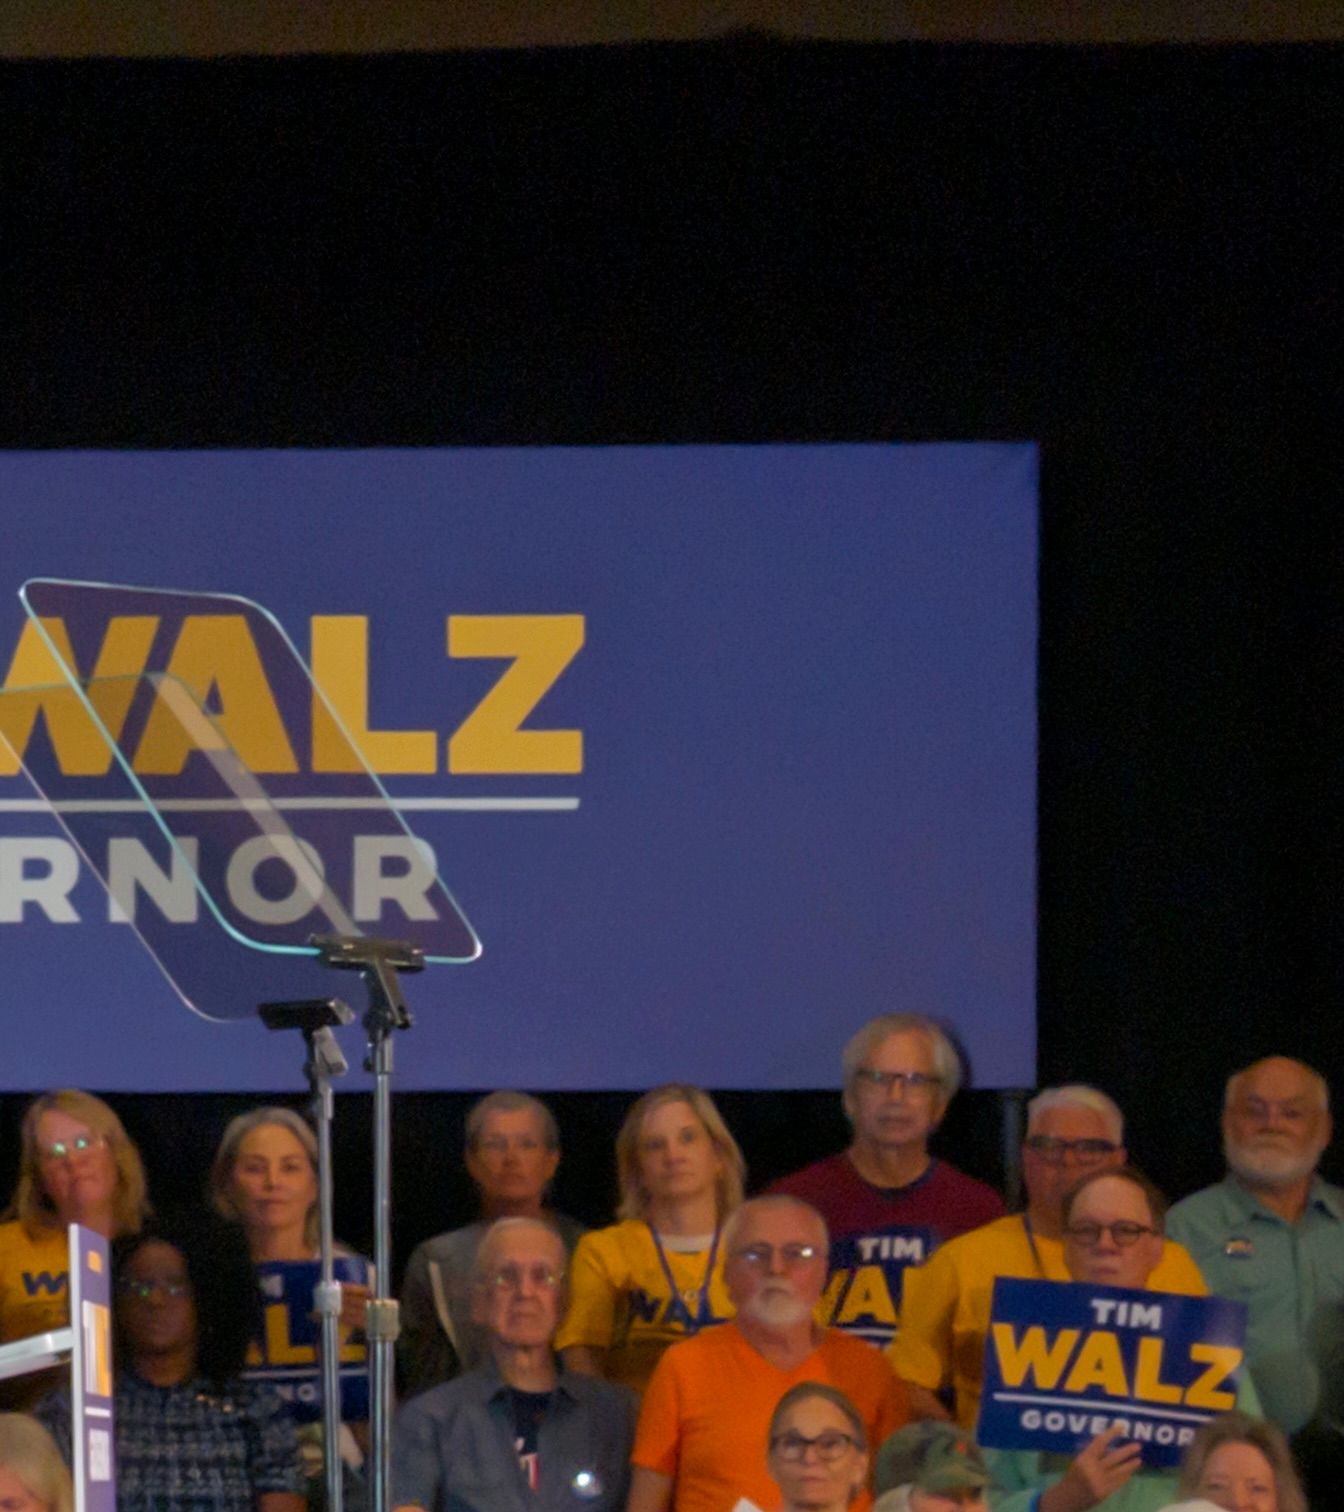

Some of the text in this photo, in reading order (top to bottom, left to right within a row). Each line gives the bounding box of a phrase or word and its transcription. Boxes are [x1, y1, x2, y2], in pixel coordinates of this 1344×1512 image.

[857, 1236, 925, 1261] TIM
[1091, 1297, 1162, 1331] TIM
[991, 1322, 1244, 1411] WALZ
